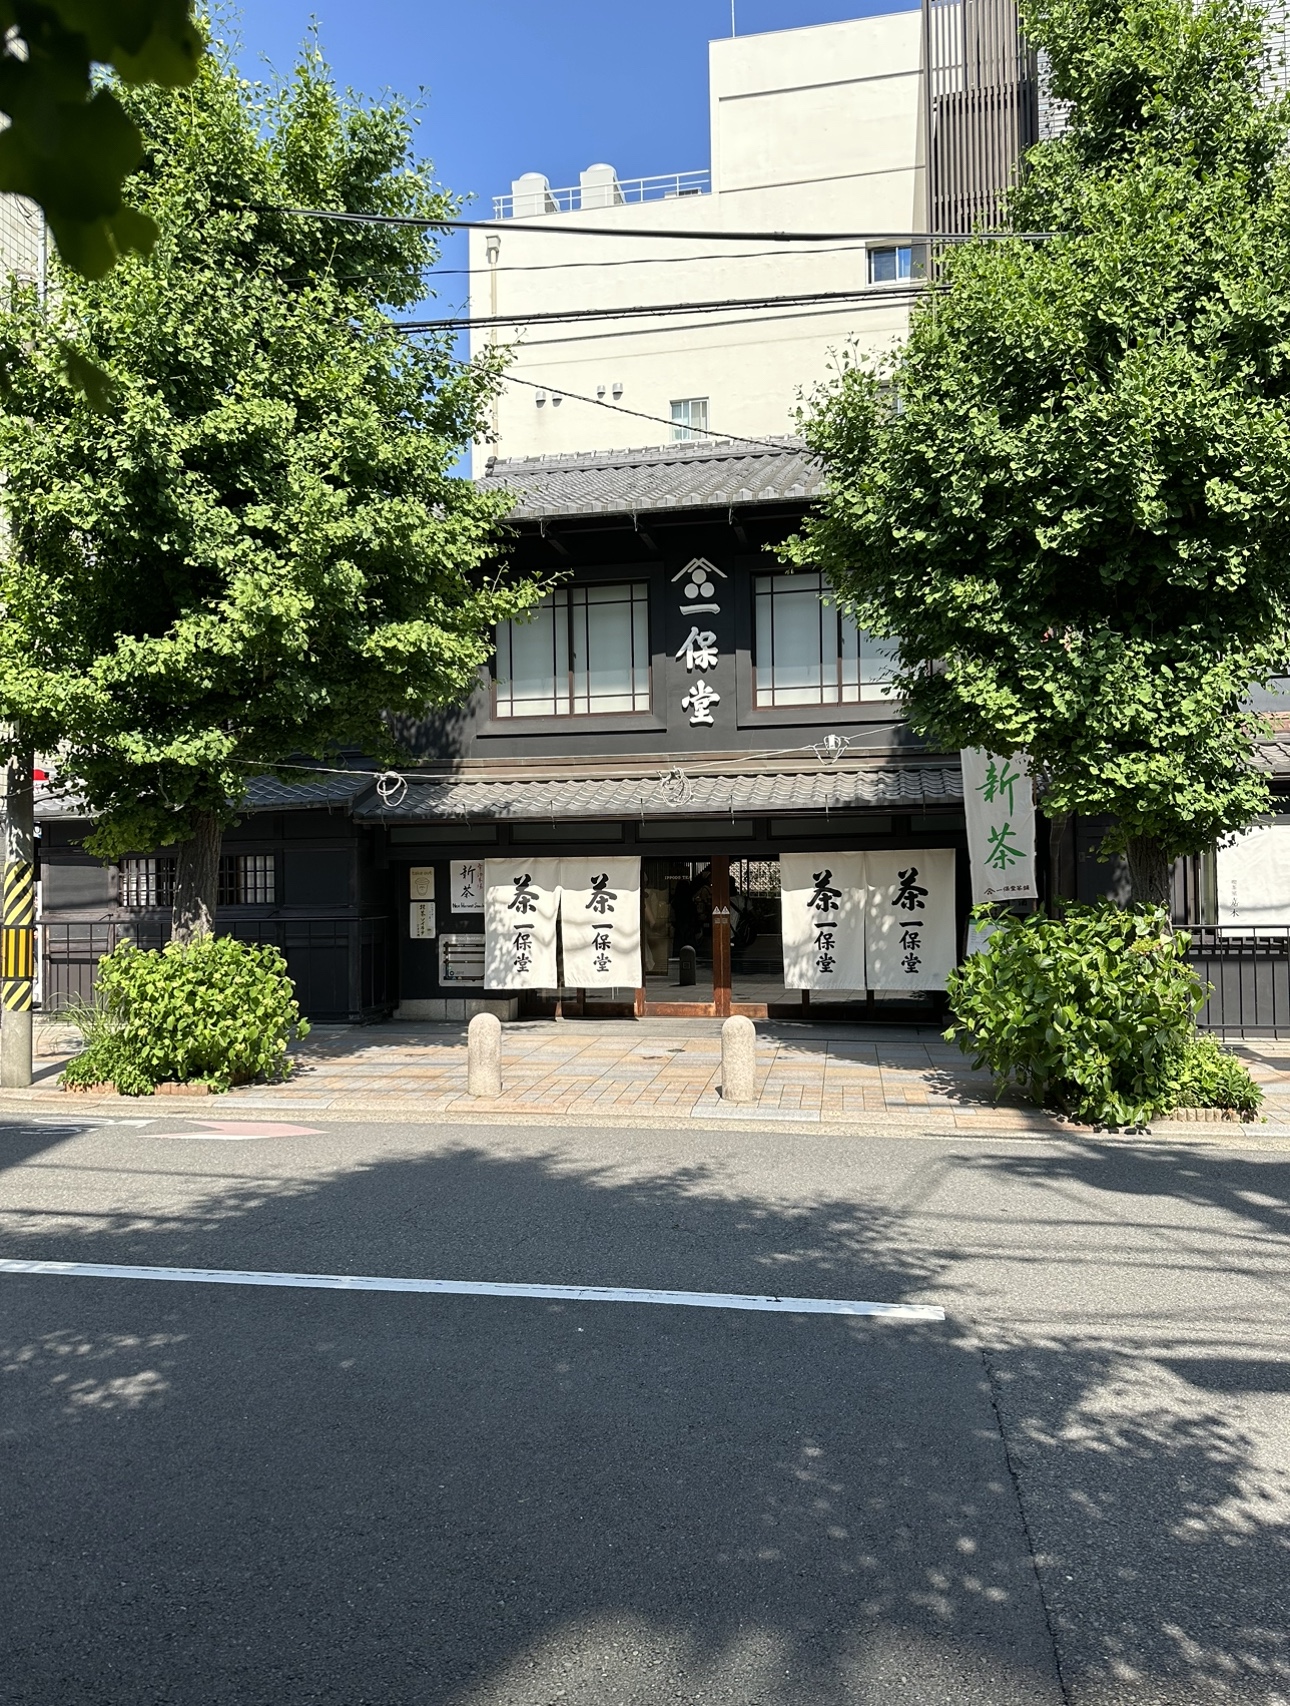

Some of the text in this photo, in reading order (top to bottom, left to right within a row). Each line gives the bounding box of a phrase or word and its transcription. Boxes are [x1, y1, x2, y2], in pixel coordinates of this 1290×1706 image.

[675, 602, 721, 726] 一保堂
[975, 760, 1028, 871] 新茶
[459, 865, 476, 898] 新茶
